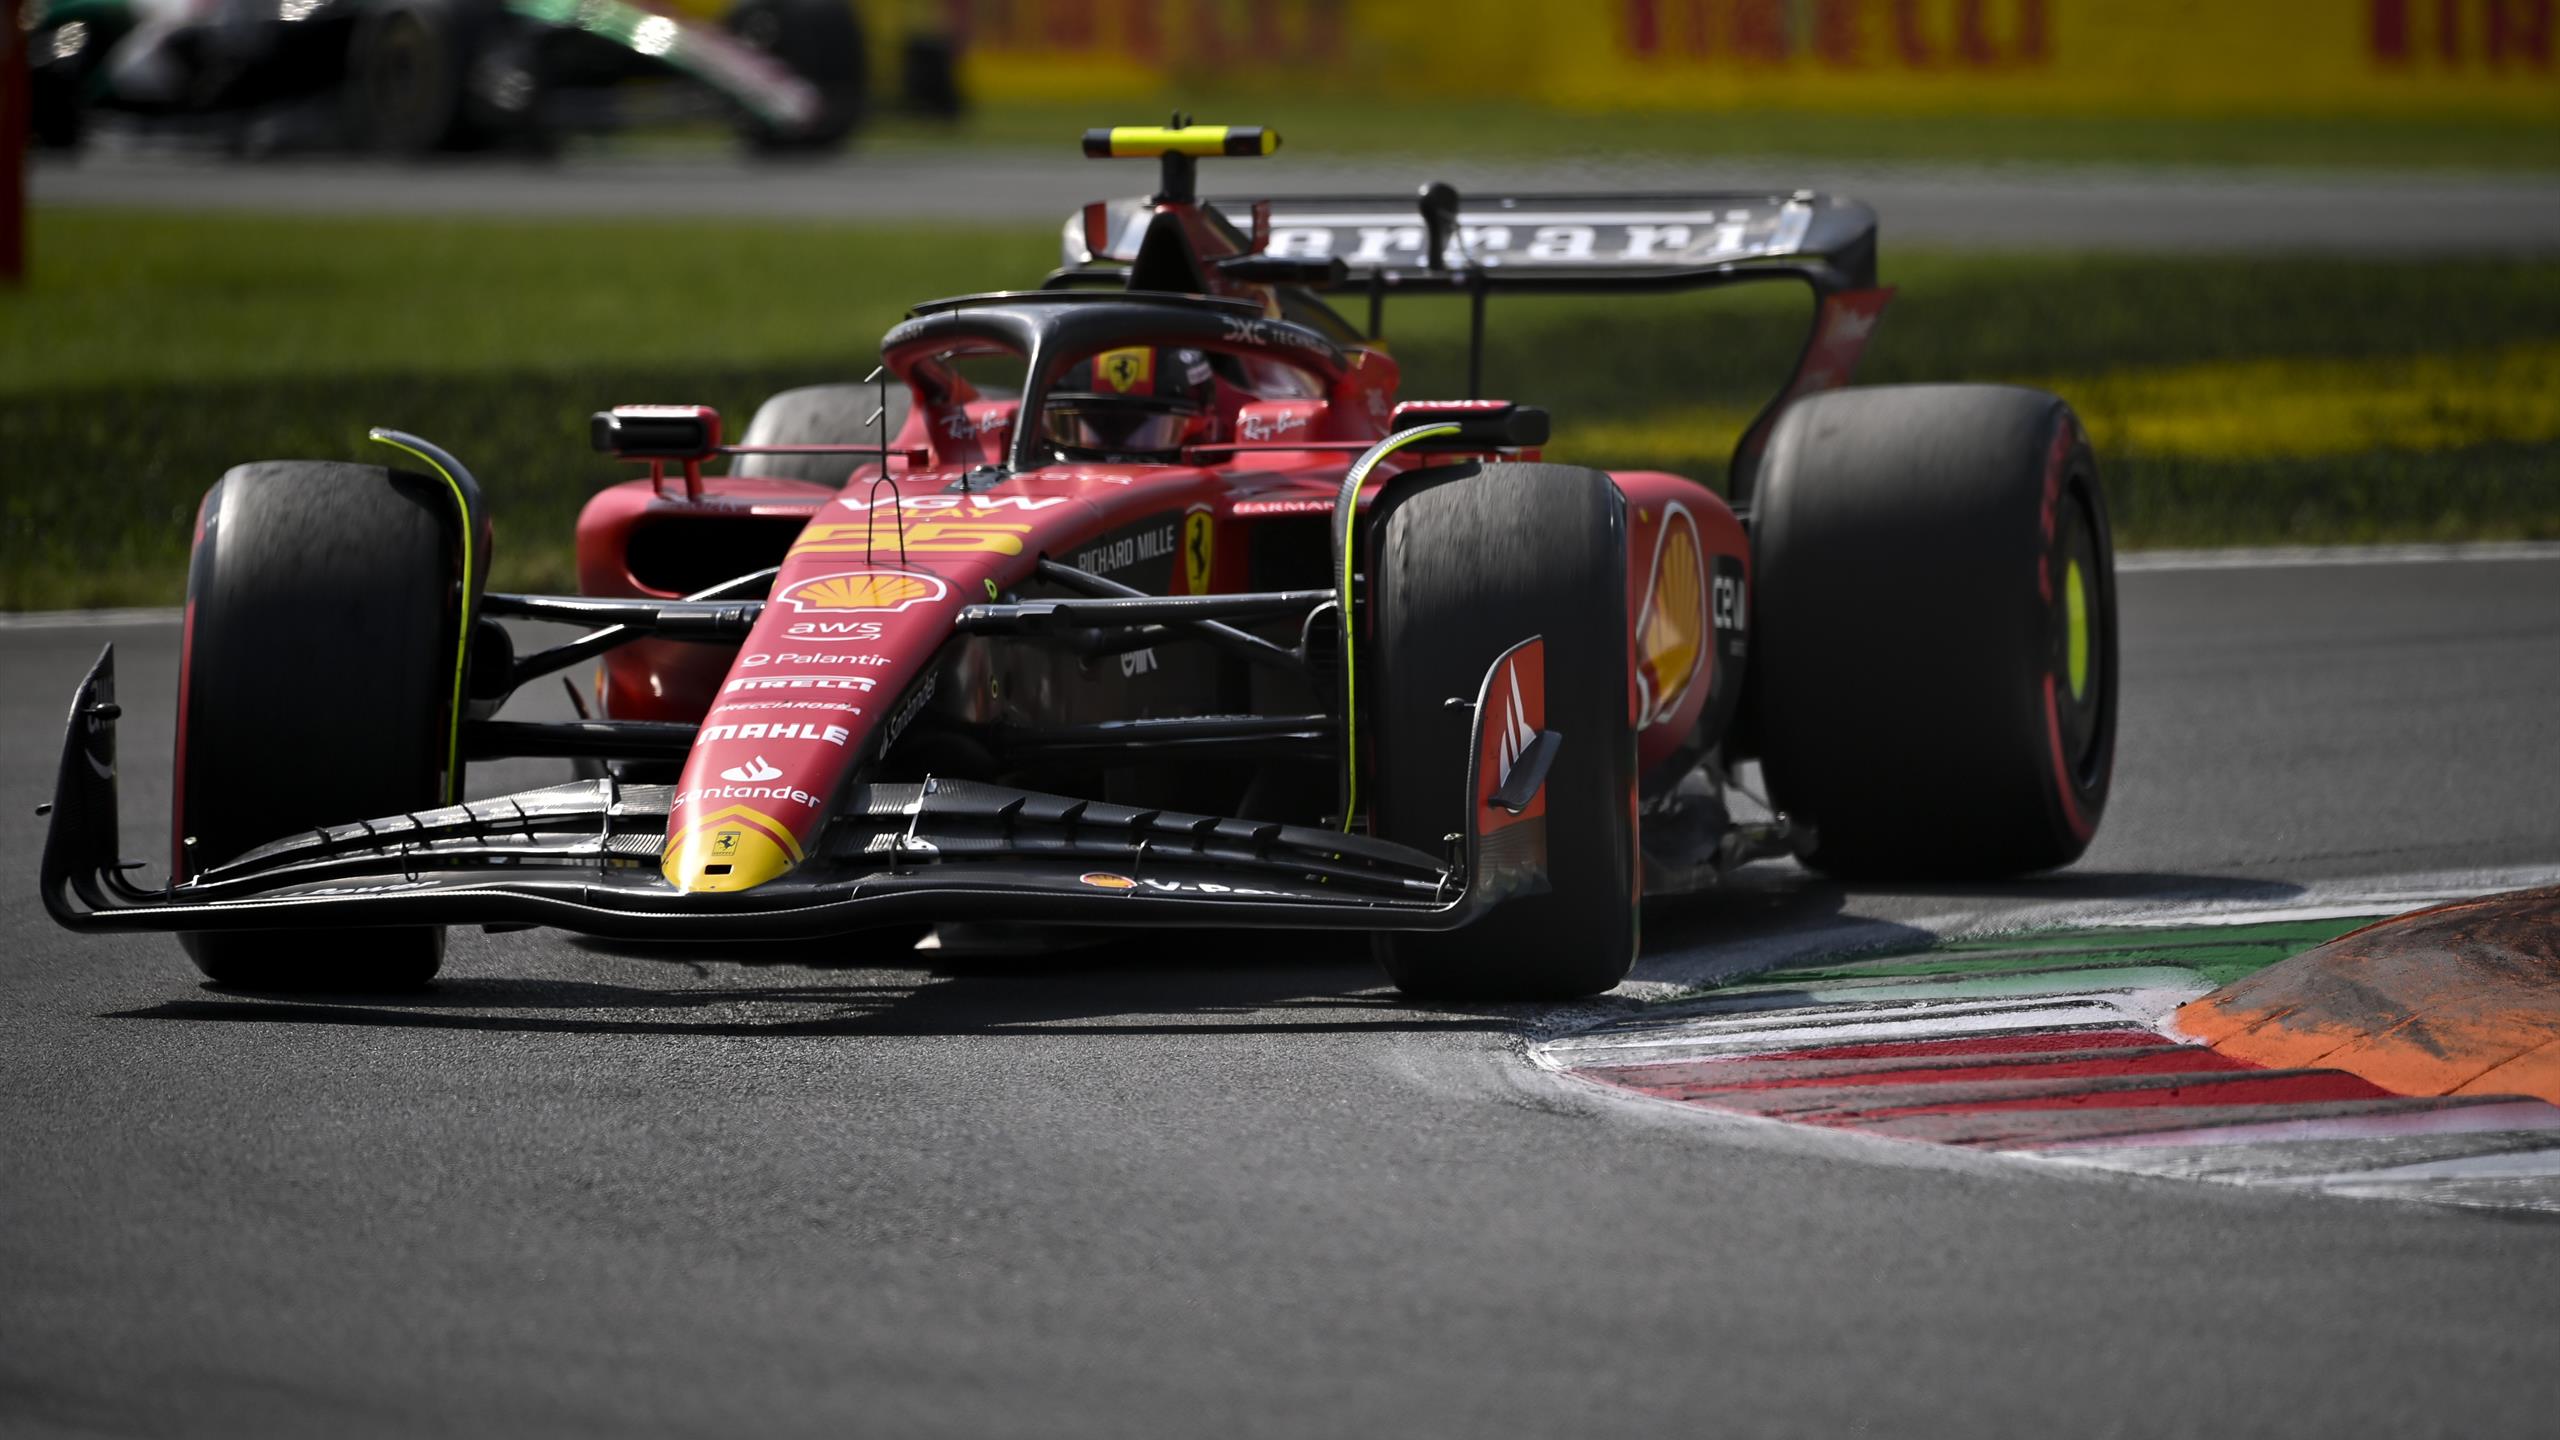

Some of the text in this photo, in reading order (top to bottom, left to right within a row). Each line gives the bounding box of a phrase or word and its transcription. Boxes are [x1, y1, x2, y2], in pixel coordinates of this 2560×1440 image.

[838, 495, 1070, 511] VGW
[871, 507, 1003, 519] PLAY
[784, 523, 1033, 559] 55
[1078, 524, 1176, 577] RICHARD MILLE
[787, 622, 884, 635] aws
[775, 652, 892, 667] Palantir
[723, 675, 877, 695] PIRELLI
[697, 722, 850, 747] MAHLE
[671, 784, 822, 813] Santander
